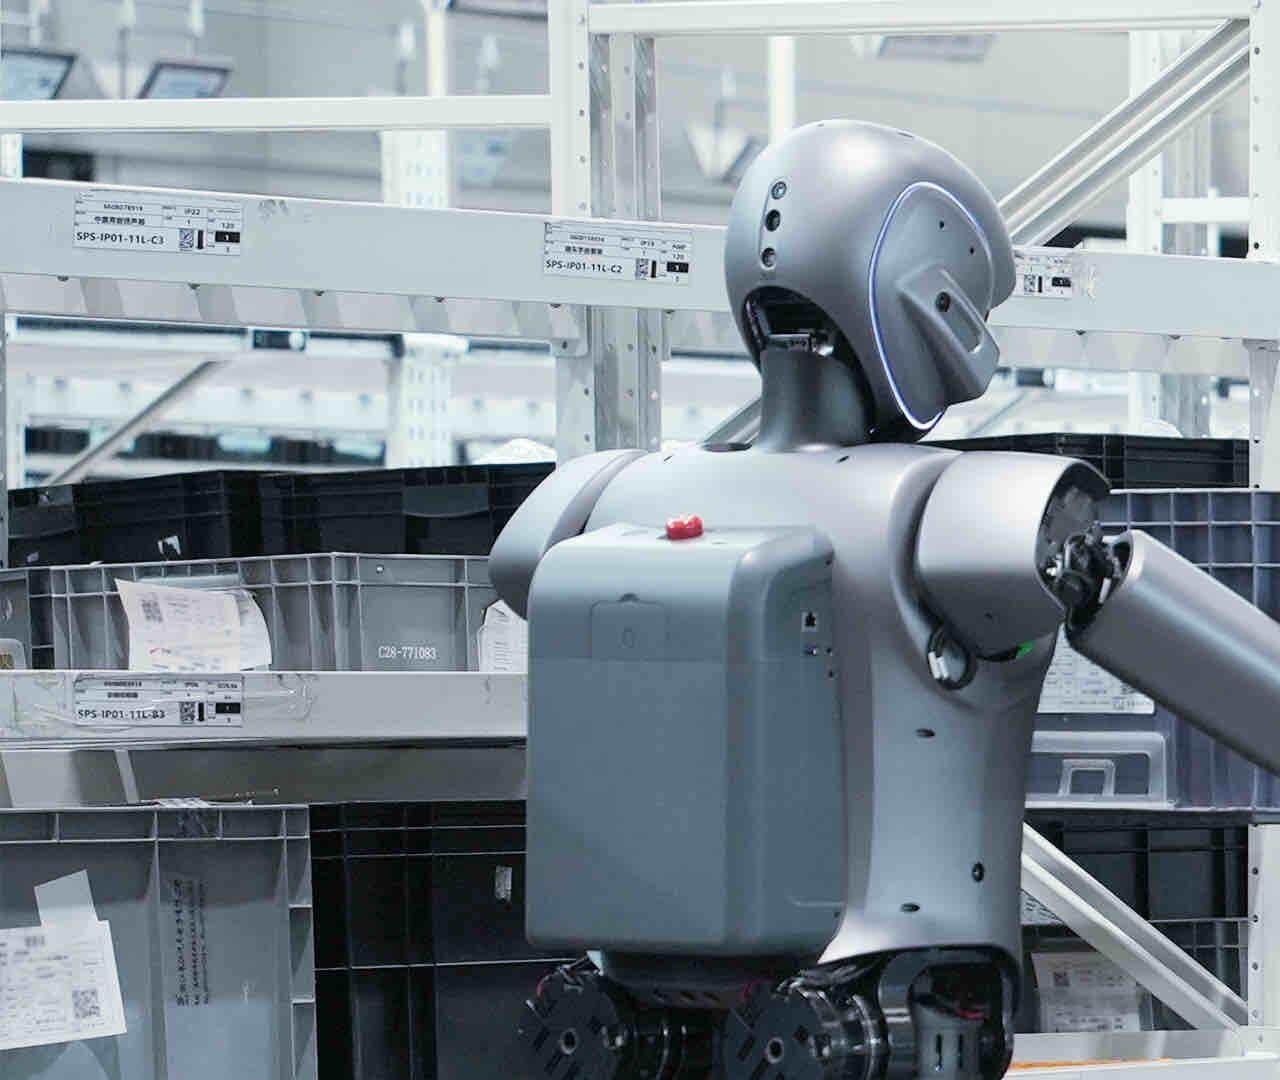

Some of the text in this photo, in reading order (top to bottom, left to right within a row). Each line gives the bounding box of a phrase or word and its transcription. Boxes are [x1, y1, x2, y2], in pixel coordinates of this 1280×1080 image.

[76, 231, 165, 246] SPS-IP01-11L-C3
[546, 259, 623, 274] SPS-IP01-11L-C2
[77, 708, 166, 721] SPS-IP01-11L-B3
